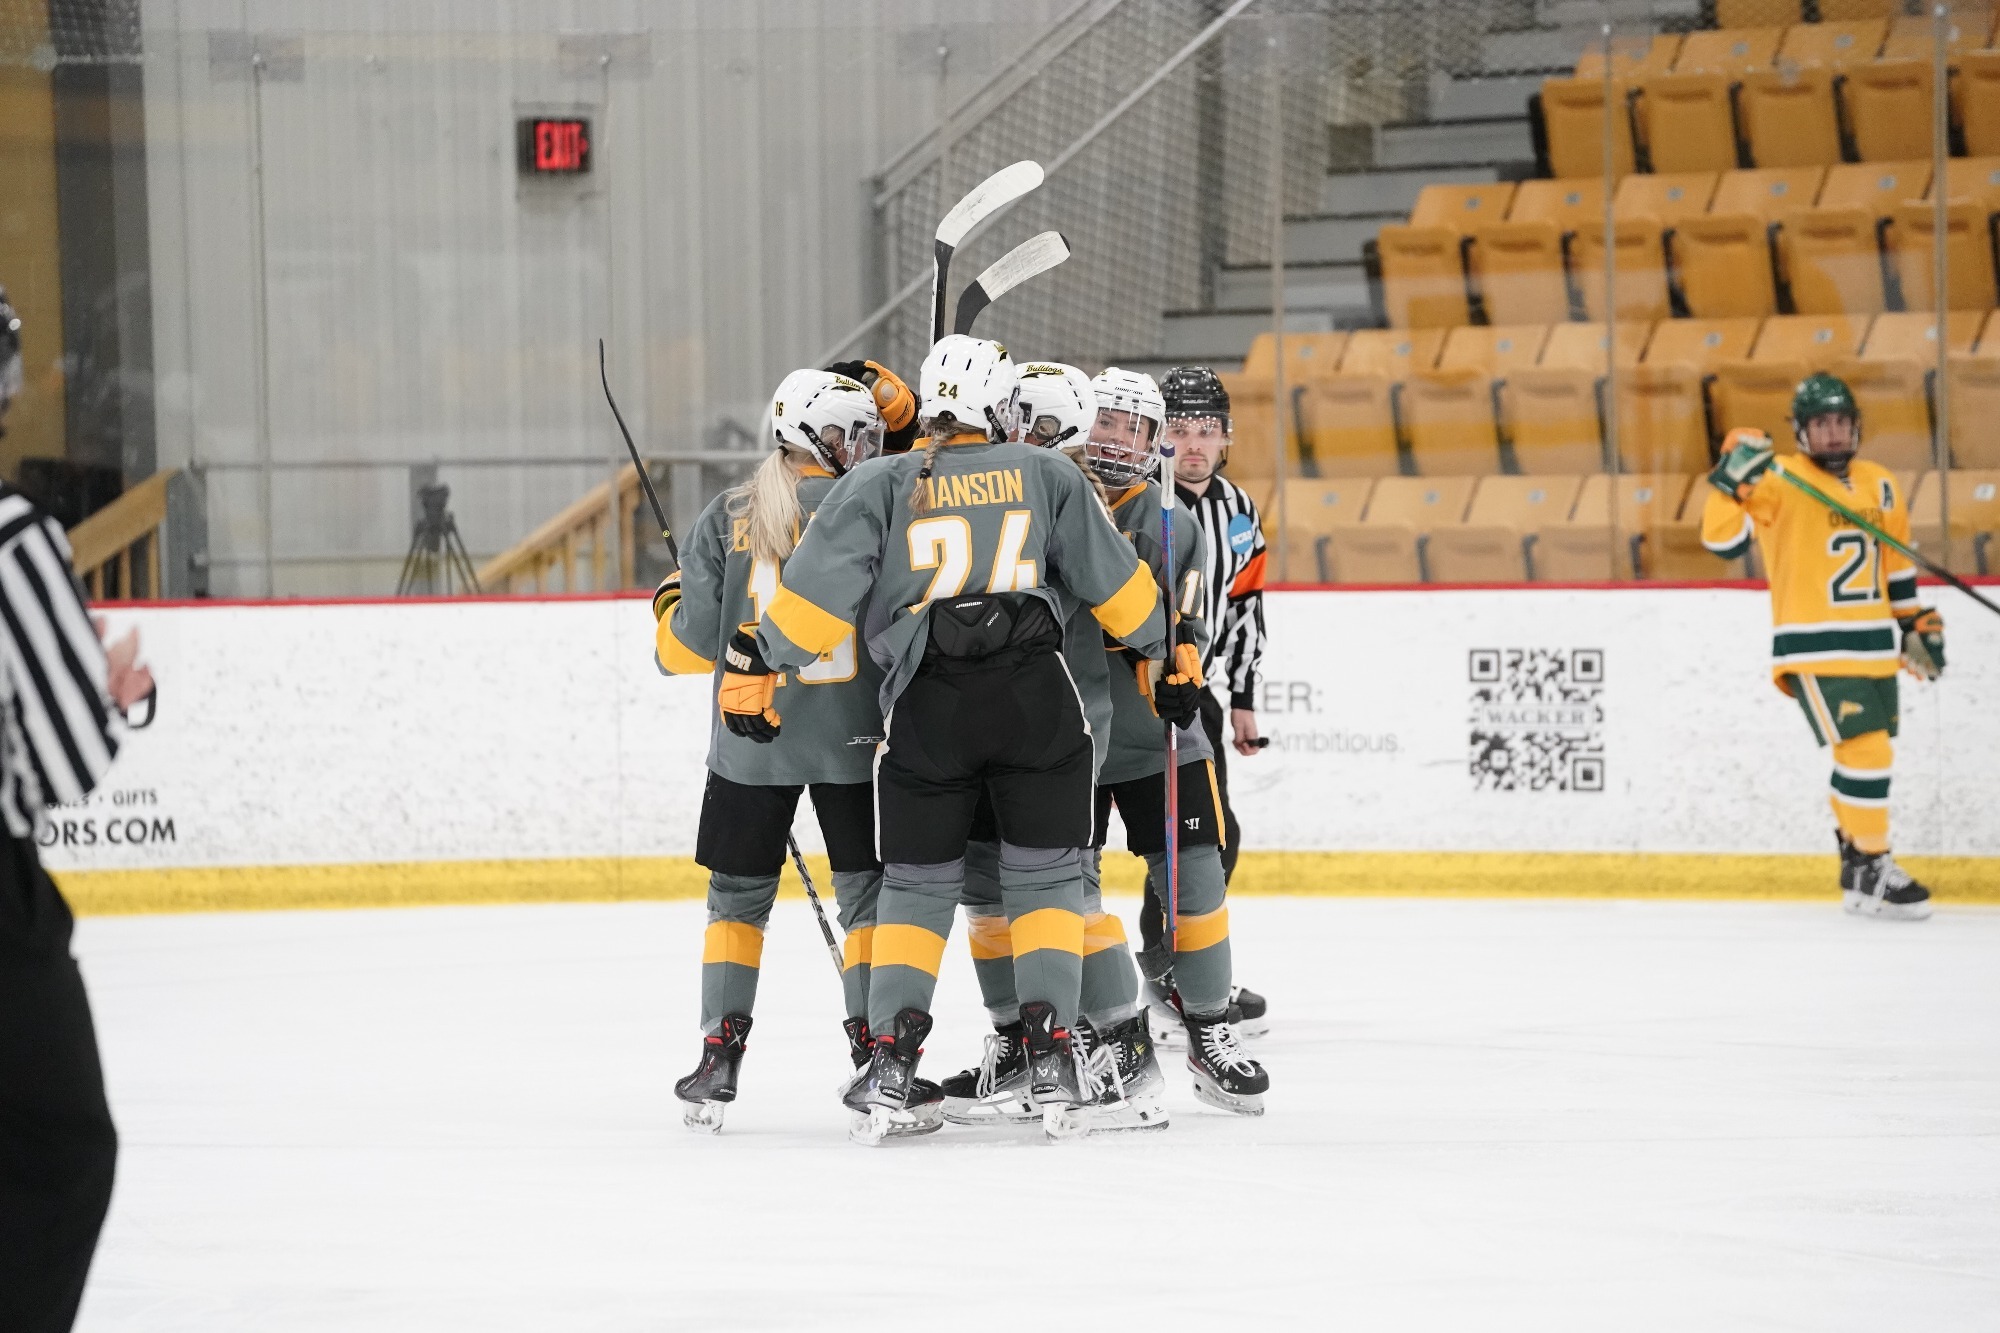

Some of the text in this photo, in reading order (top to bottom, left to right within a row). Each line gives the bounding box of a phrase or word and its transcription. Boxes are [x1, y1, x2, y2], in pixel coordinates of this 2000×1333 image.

[536, 121, 582, 169] EXIT
[938, 381, 958, 399] 24
[775, 401, 784, 416] 16
[808, 431, 833, 459] BUER
[906, 510, 1038, 615] 24
[1487, 710, 1584, 723] WACKER
[112, 788, 159, 807] GIFTS
[1200, 1057, 1219, 1078] CCM
